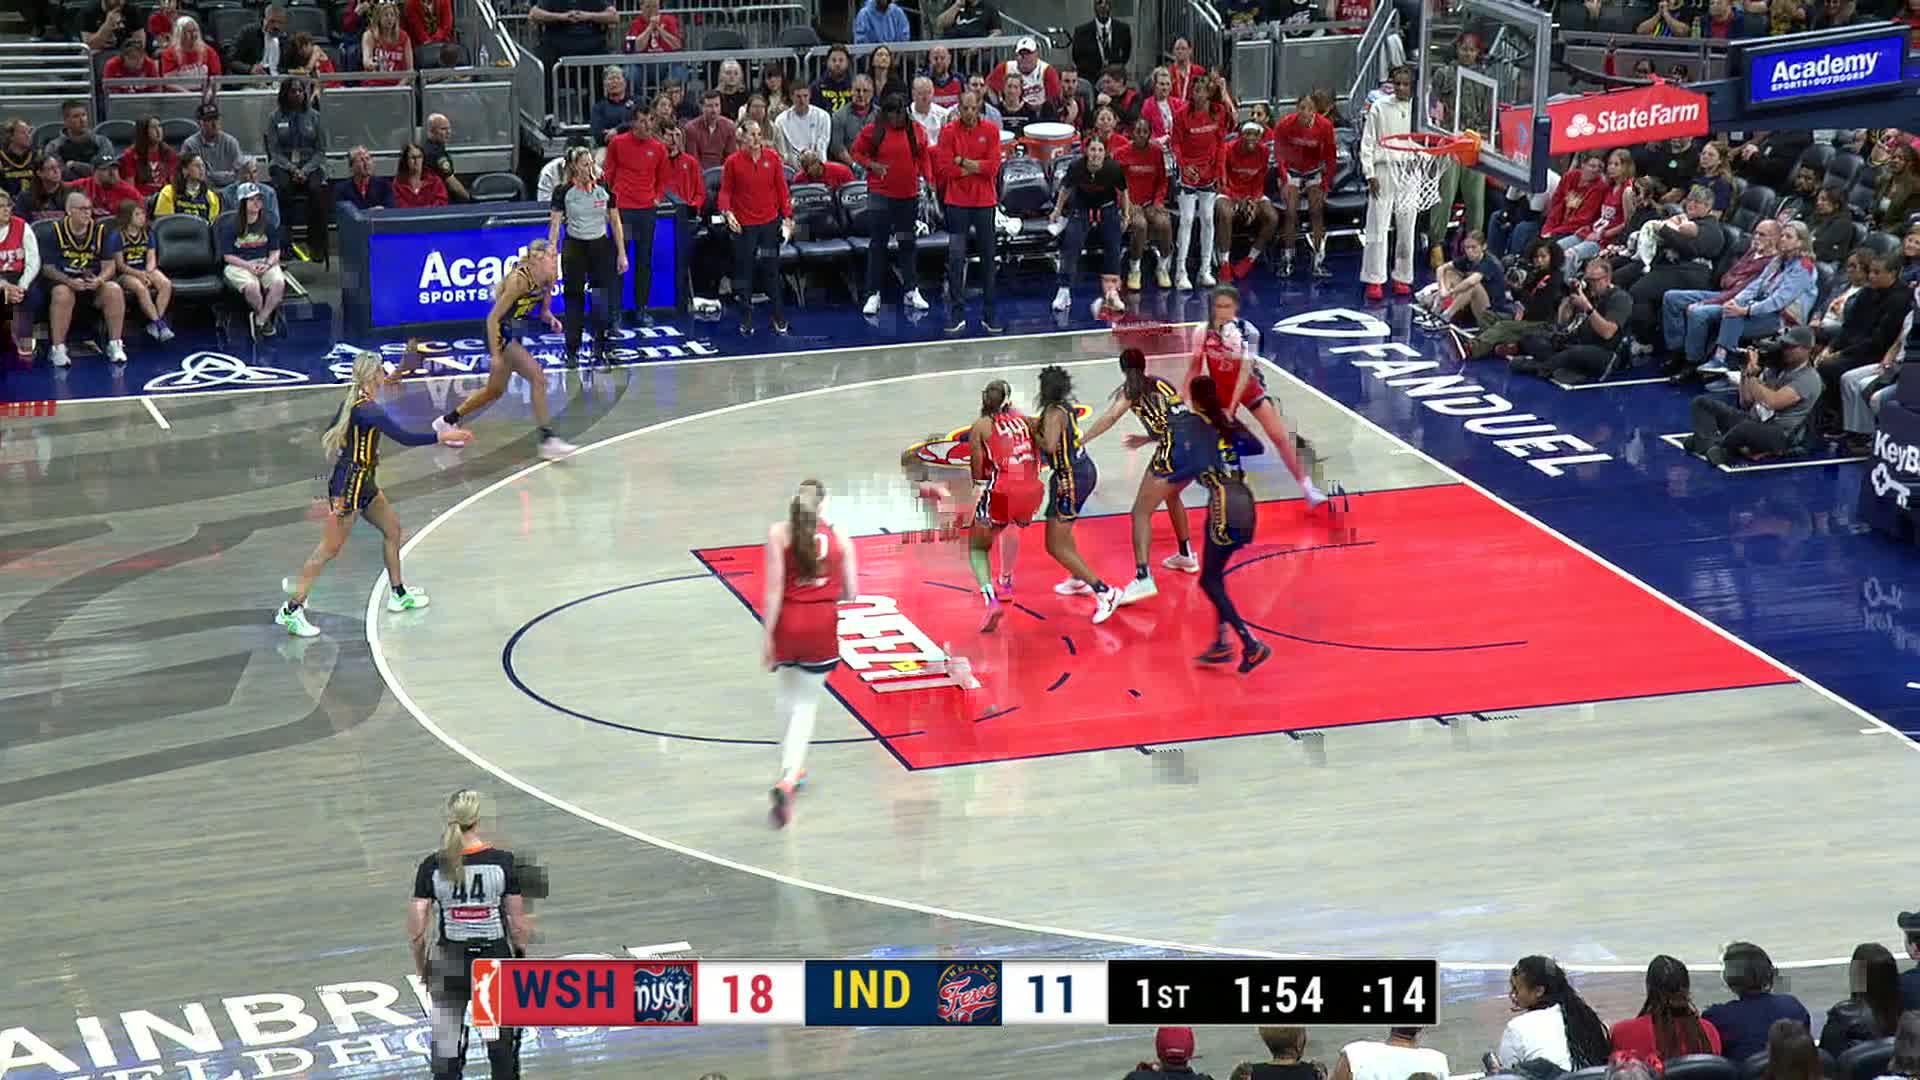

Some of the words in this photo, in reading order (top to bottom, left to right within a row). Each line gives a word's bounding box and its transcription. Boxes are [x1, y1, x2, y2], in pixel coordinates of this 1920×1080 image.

[1770, 51, 1878, 82] Academy
[1329, 342, 1613, 478] FANDUEL
[452, 873, 486, 903] 44
